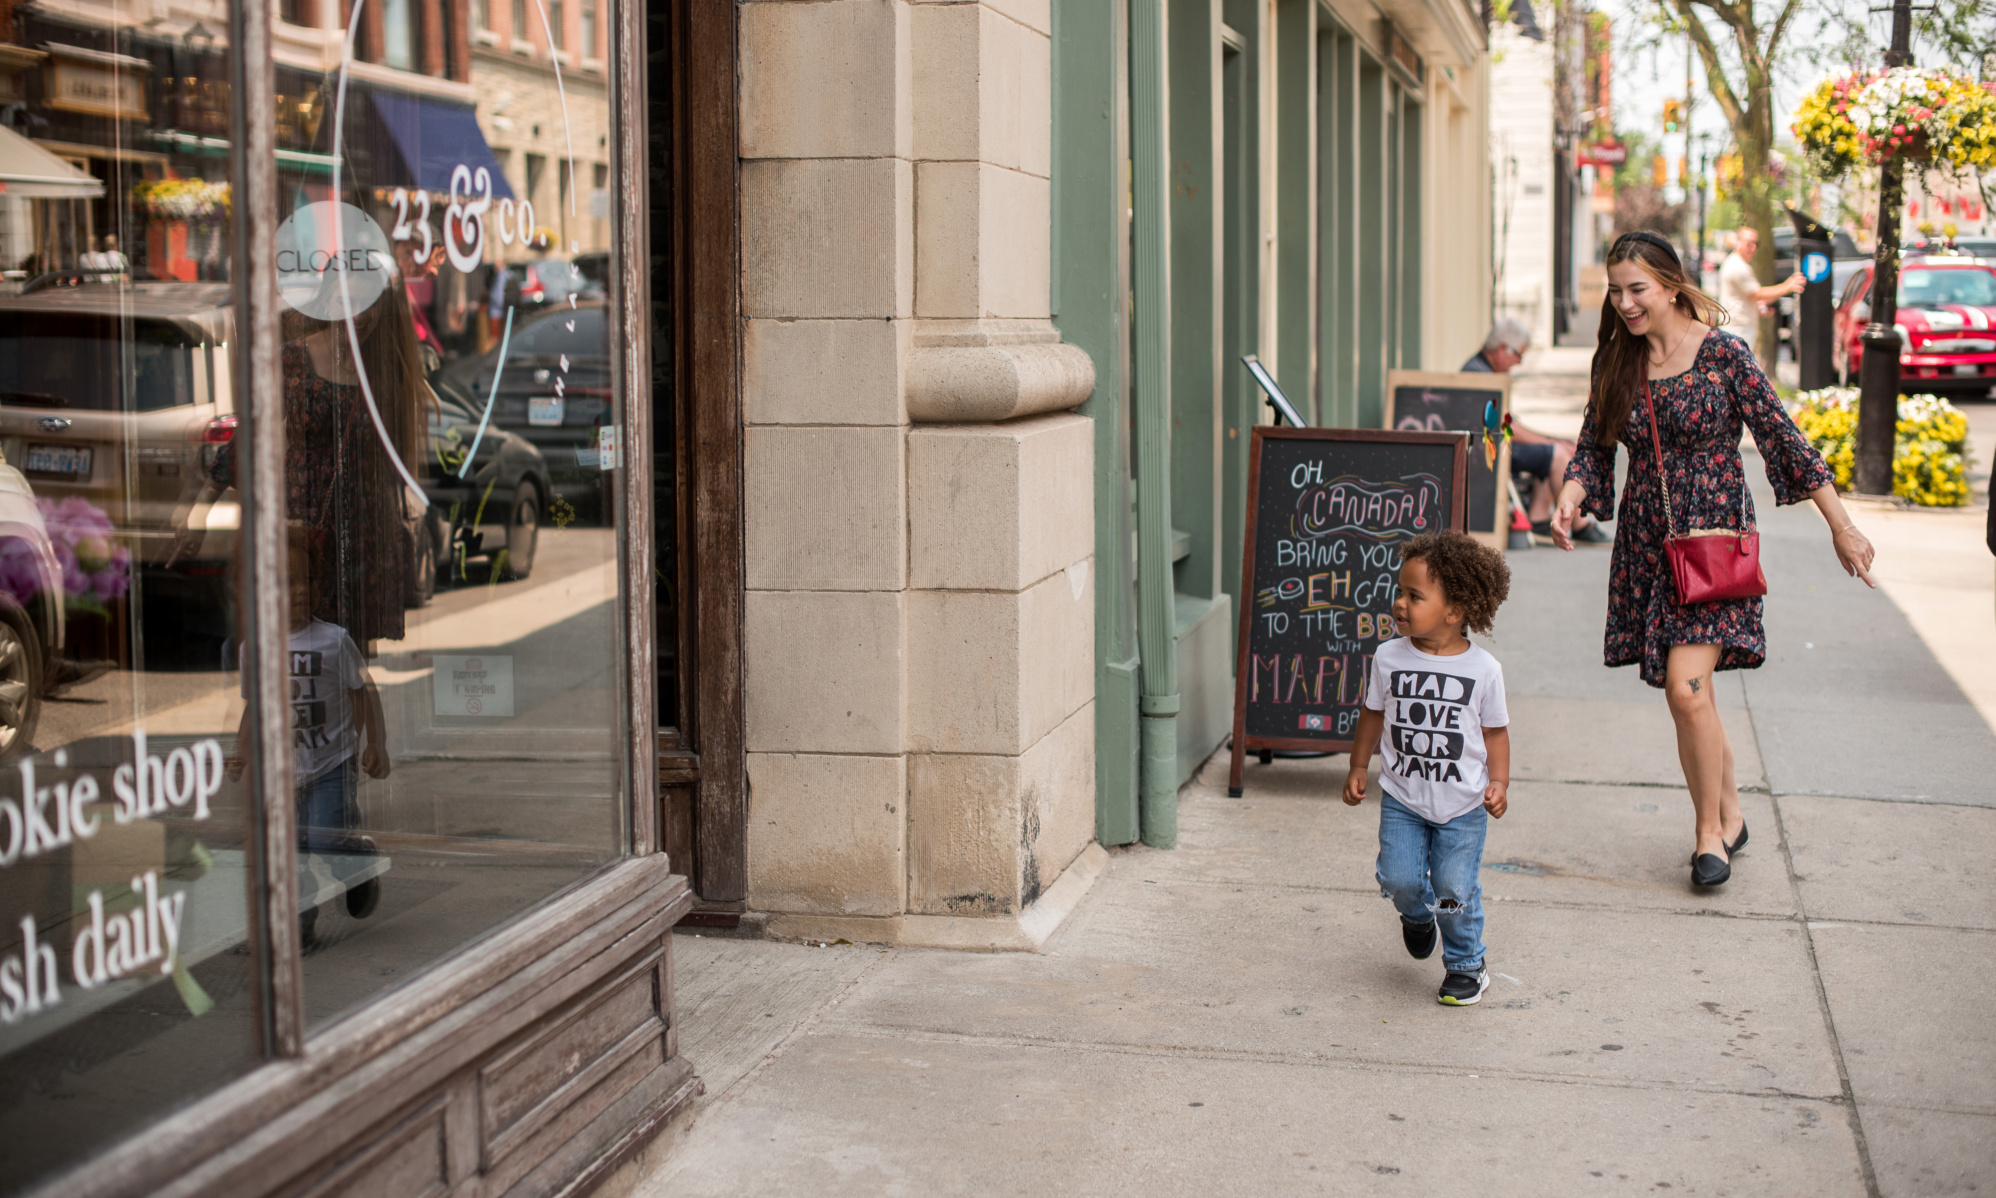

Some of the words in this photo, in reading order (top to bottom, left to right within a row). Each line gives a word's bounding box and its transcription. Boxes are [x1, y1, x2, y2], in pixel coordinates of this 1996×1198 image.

[391, 187, 432, 265] 23
[443, 164, 492, 274] &
[276, 249, 384, 273] CLOSED
[1314, 486, 1427, 530] CANADA!
[1278, 539, 1348, 568] BRING
[1308, 570, 1350, 607] EH
[1354, 571, 1398, 608] GA
[1262, 612, 1289, 638] TO
[1299, 609, 1348, 639] THE
[1357, 612, 1401, 640] BB
[1326, 640, 1361, 653] WITH
[1397, 672, 1465, 701] MAD
[1396, 700, 1462, 730] LOVE
[1400, 728, 1450, 758] FOR
[113, 728, 224, 826] shop
[1391, 752, 1463, 783] MAMA
[73, 870, 187, 989] daily
